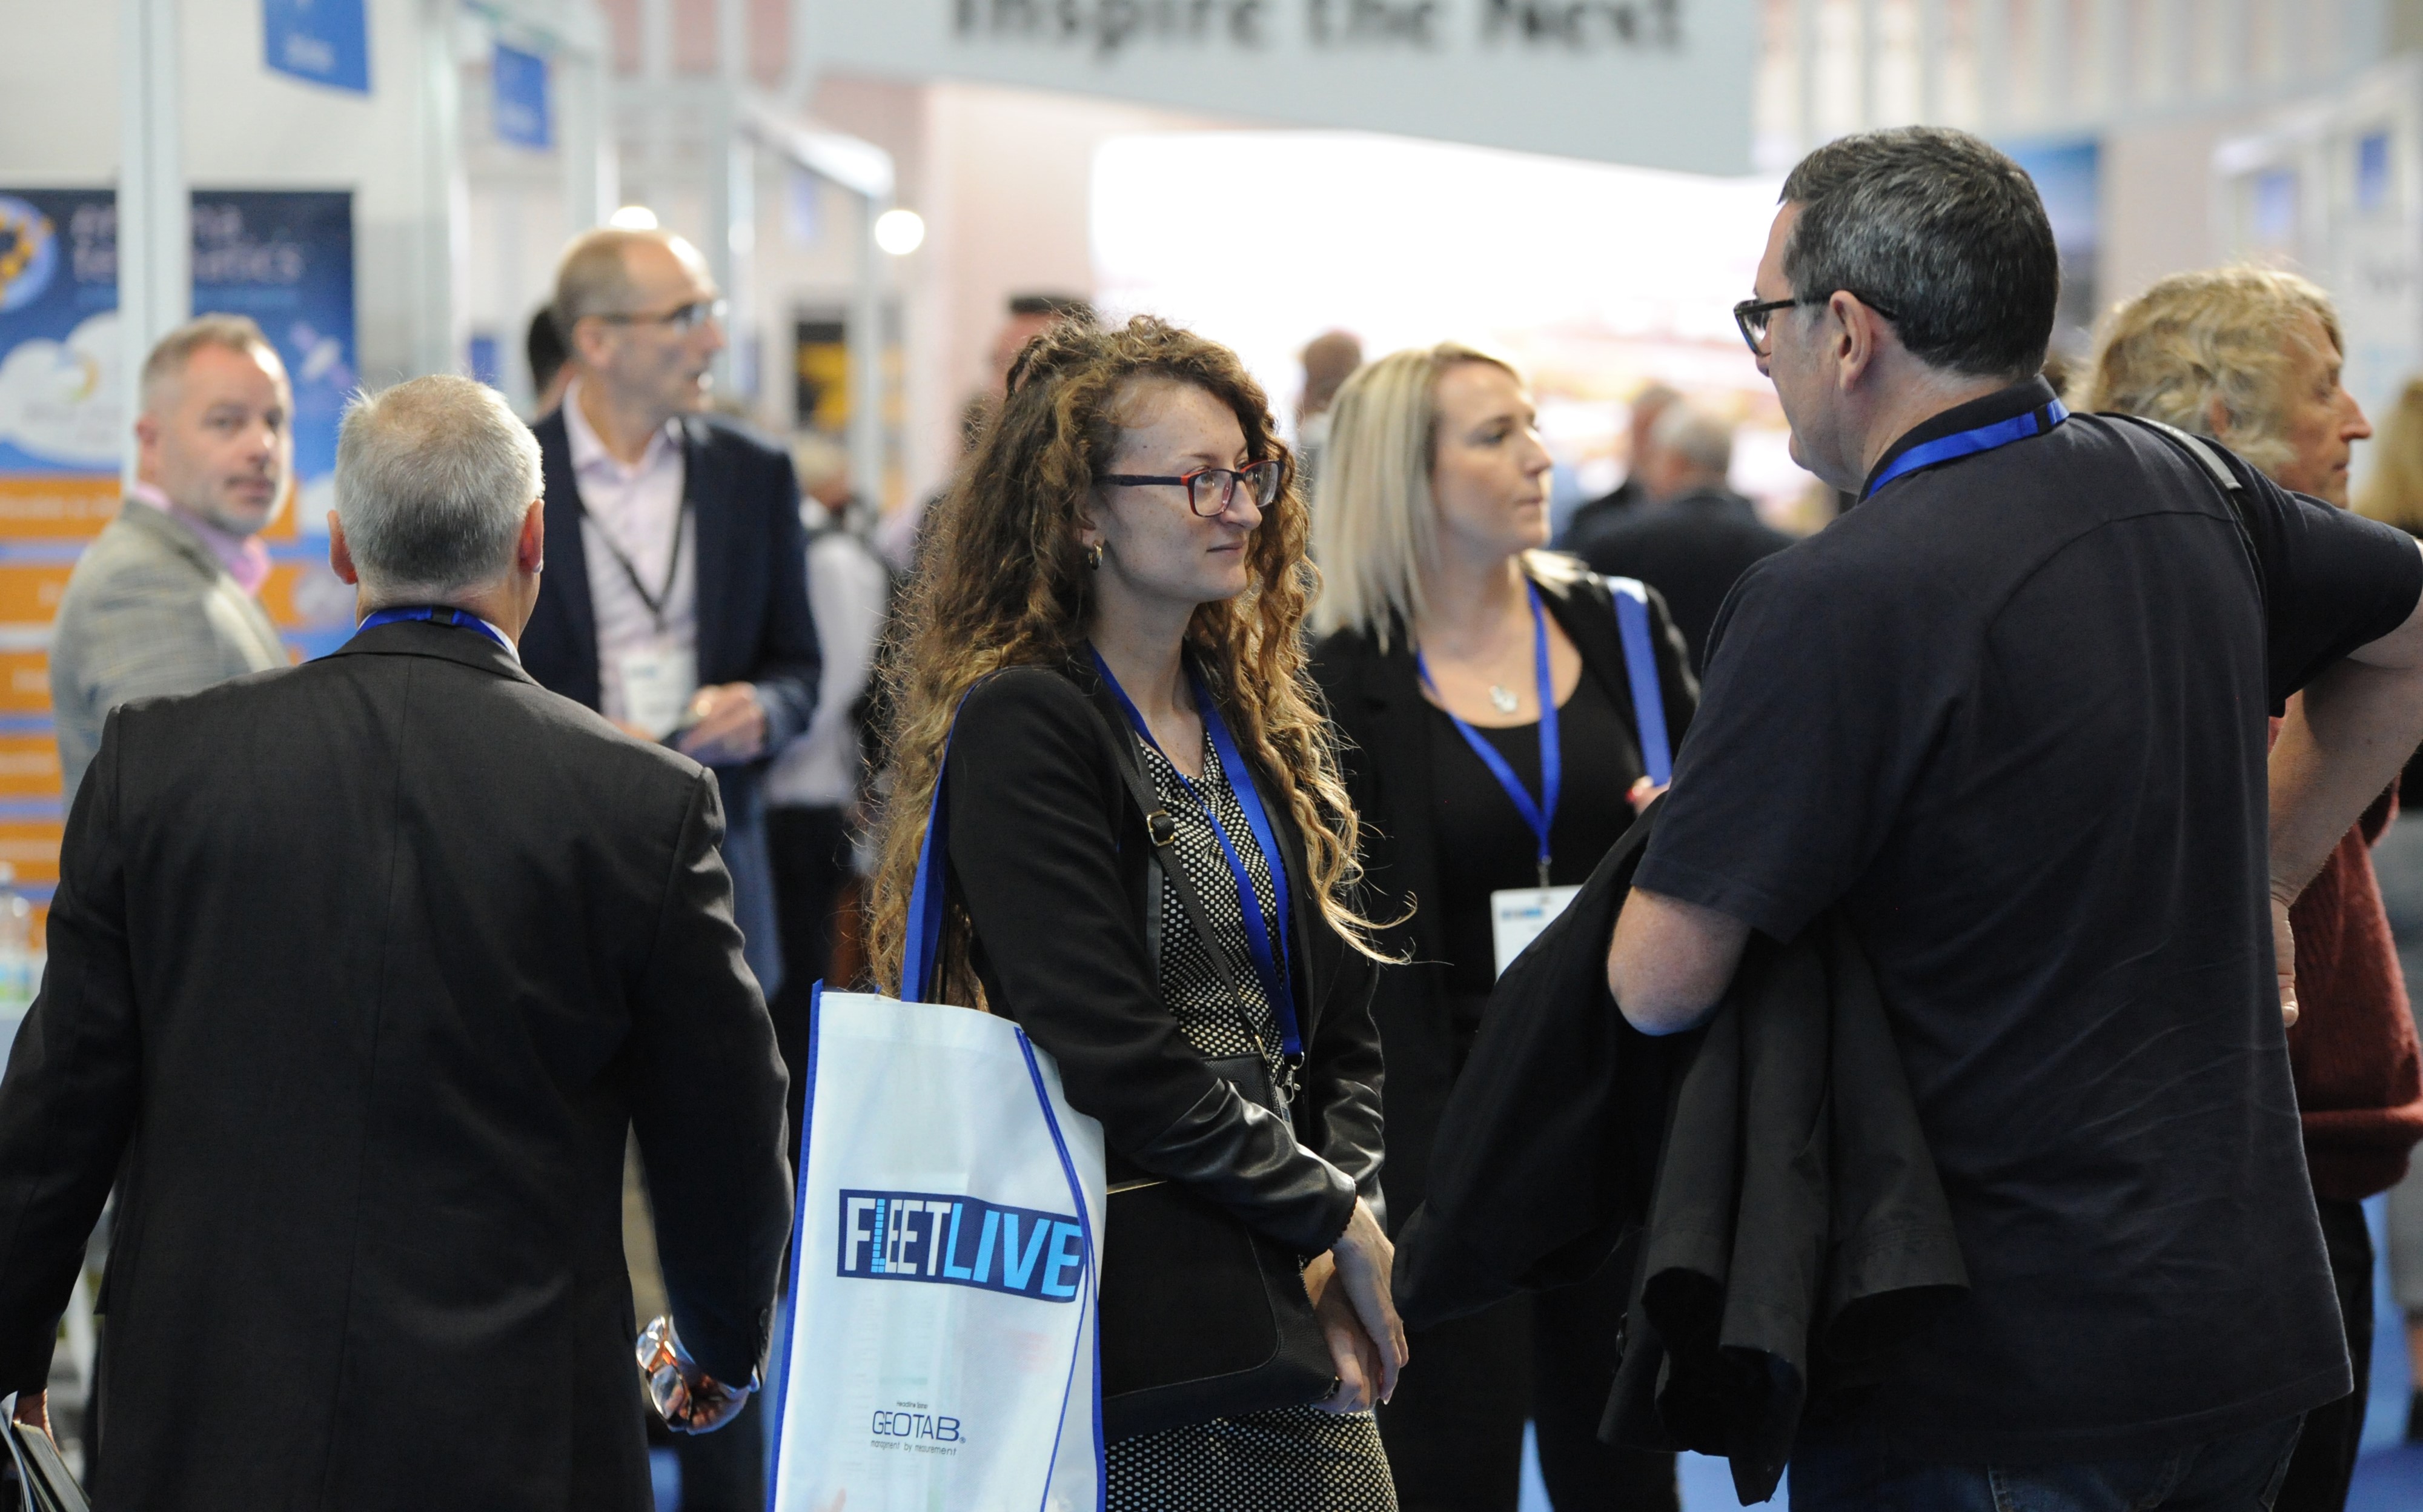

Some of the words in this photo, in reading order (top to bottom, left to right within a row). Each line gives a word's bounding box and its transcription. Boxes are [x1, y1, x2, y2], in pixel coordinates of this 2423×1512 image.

[951, 0, 1265, 63] Inspire
[1307, 0, 1439, 50] the
[904, 1442, 912, 1452] by
[915, 1444, 957, 1456] measurement
